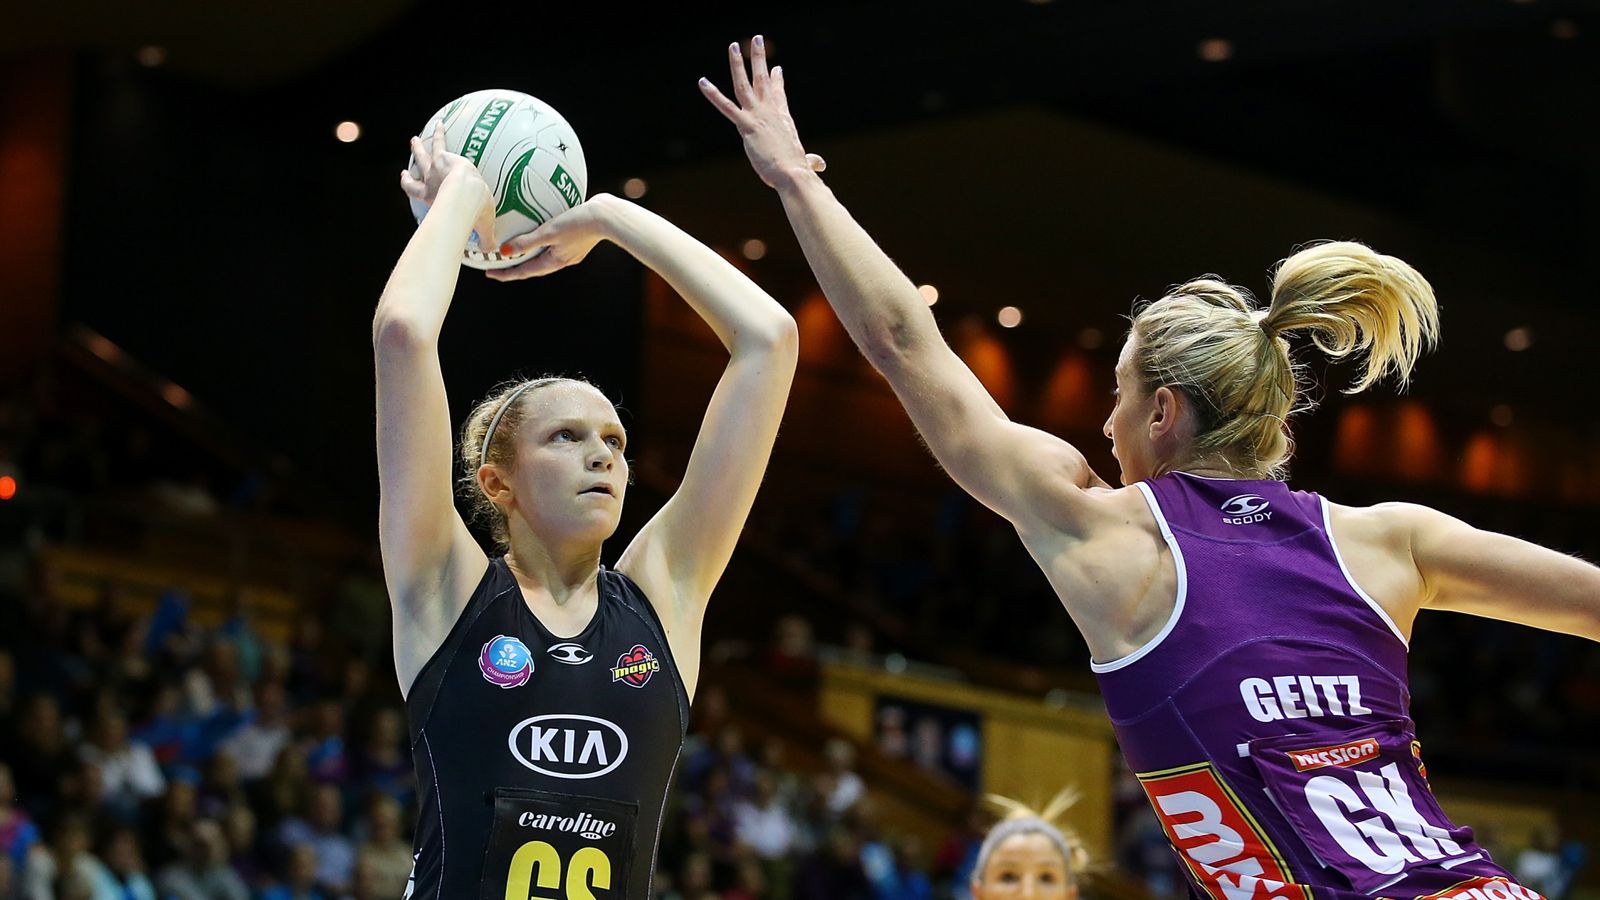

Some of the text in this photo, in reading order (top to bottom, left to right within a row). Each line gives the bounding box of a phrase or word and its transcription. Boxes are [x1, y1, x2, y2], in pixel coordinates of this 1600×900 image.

[480, 100, 508, 127] SAN
[557, 172, 578, 204] SAN
[1222, 511, 1272, 524] SCODY
[496, 658, 517, 668] ANZ
[615, 660, 658, 678] magic
[1239, 675, 1372, 722] GEITZ
[530, 725, 608, 766] KIA
[518, 811, 616, 837] caroline
[1304, 762, 1466, 875] GK
[505, 841, 611, 900] GS
